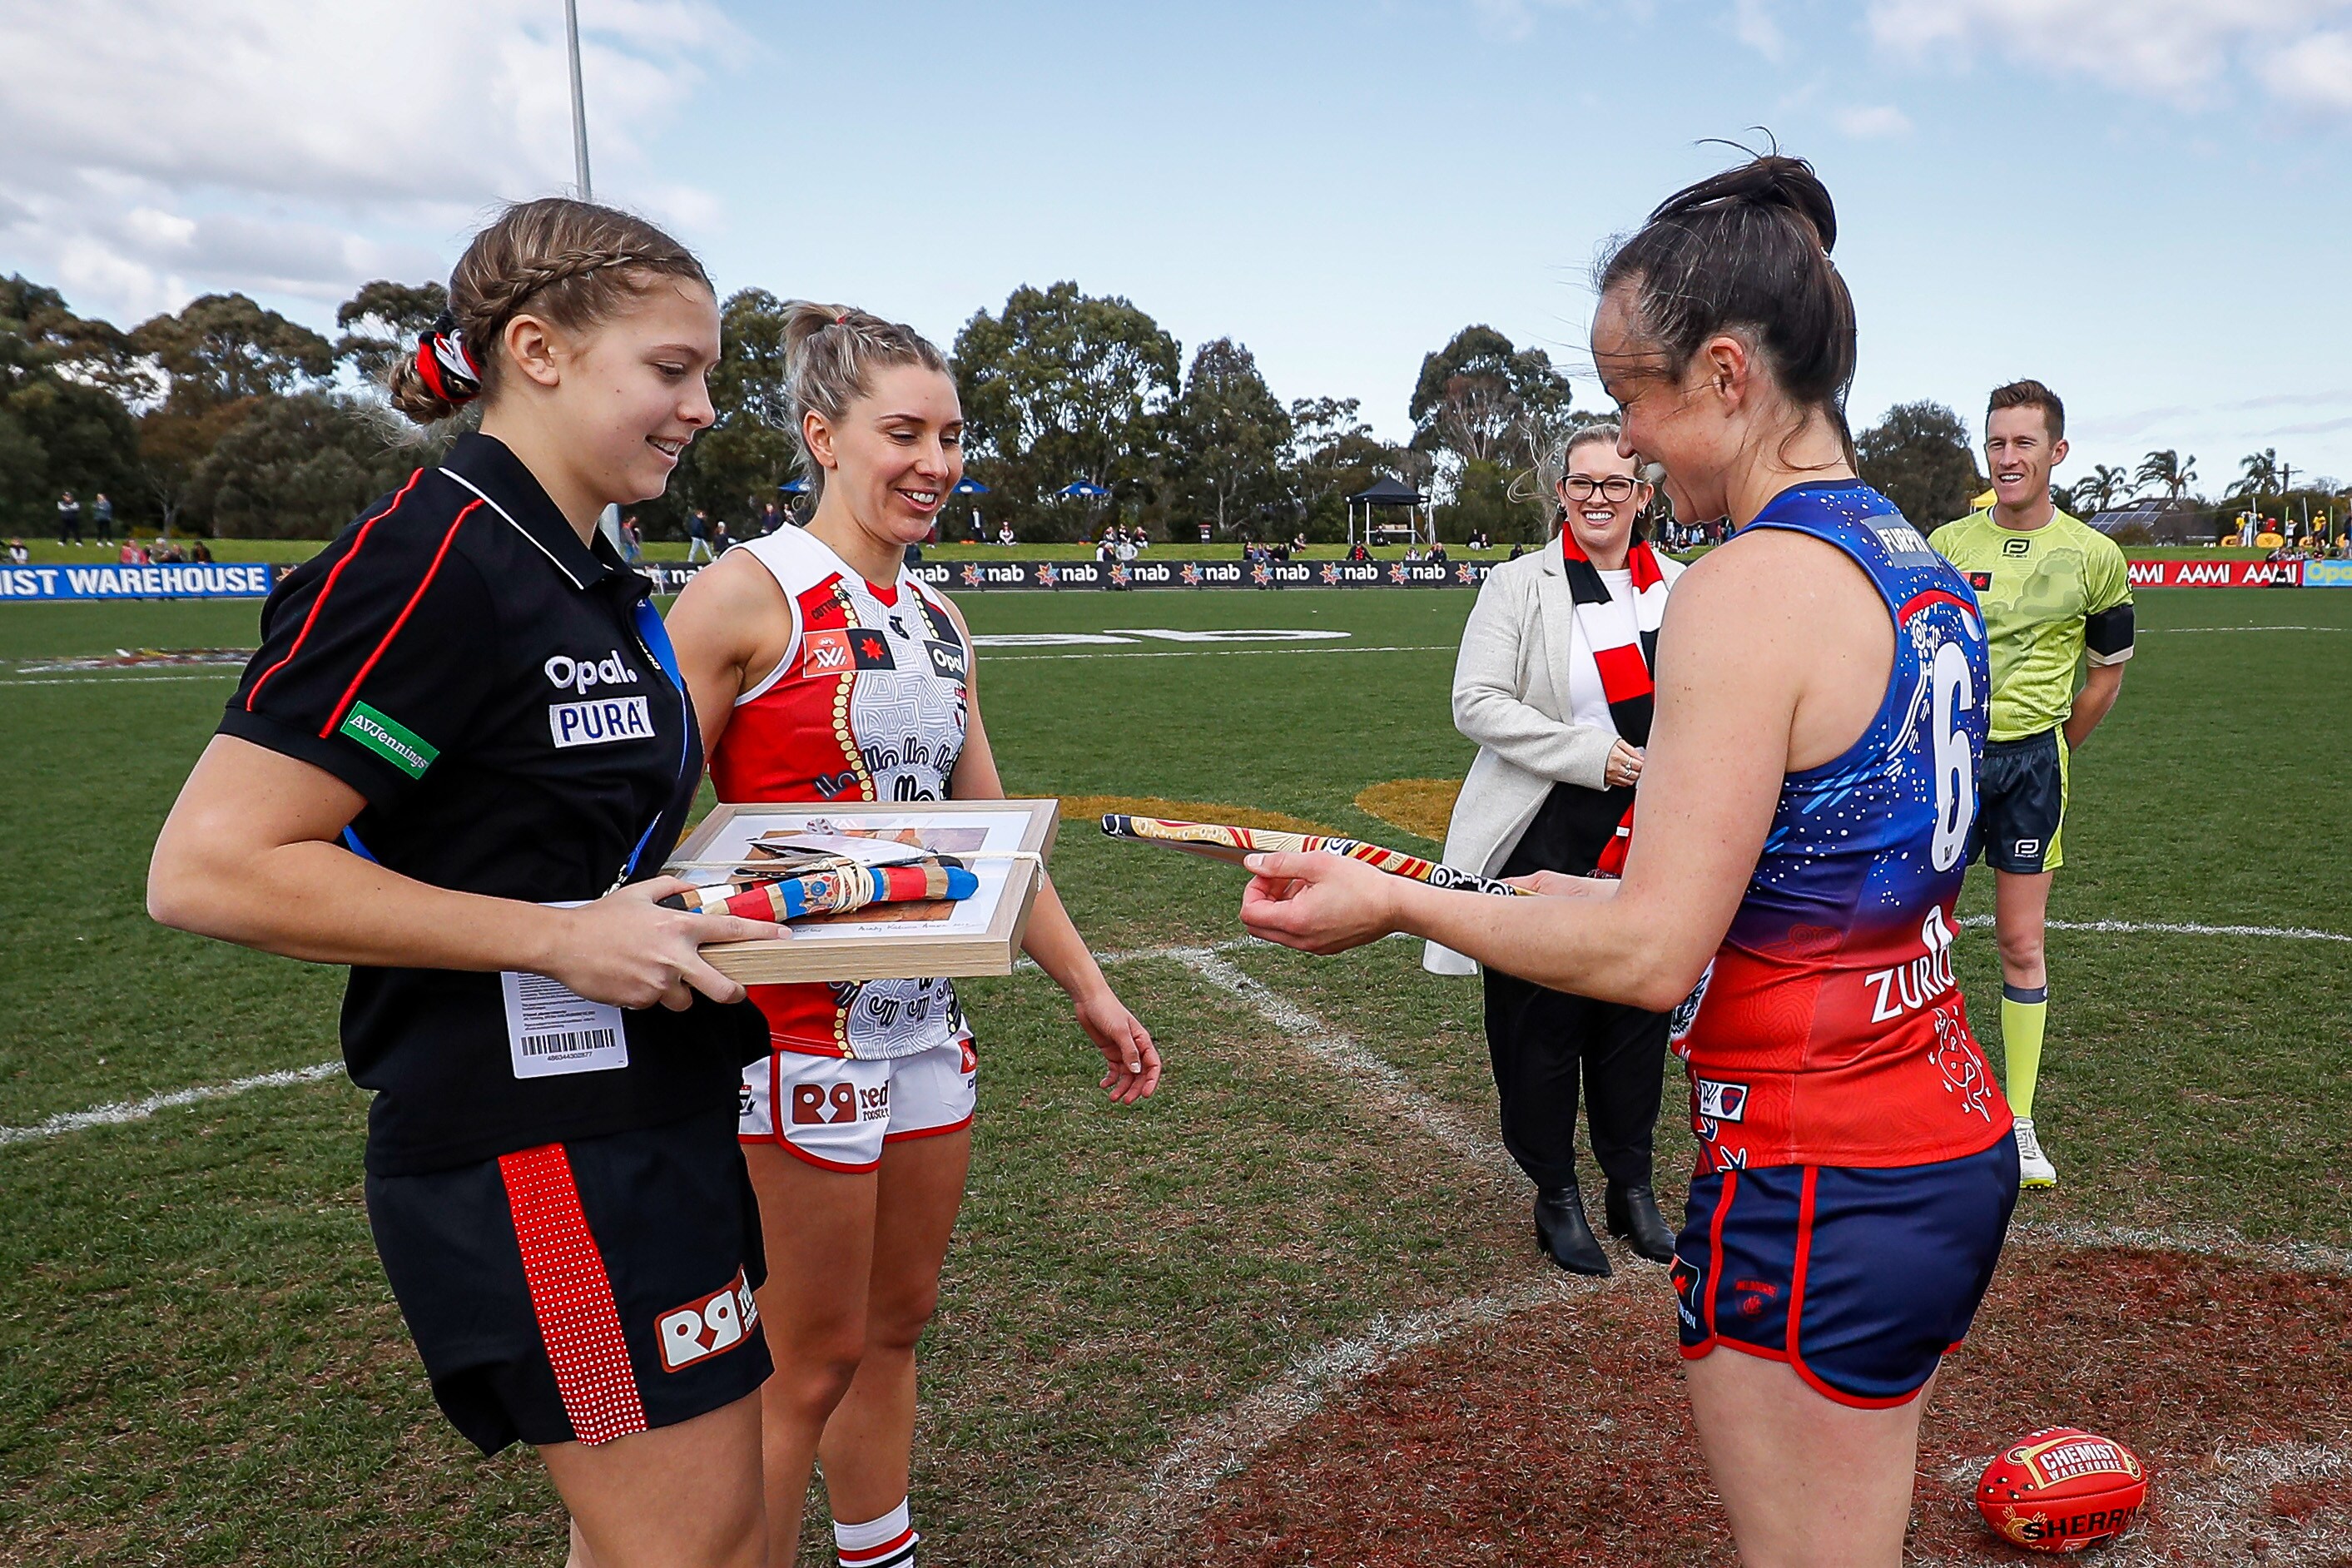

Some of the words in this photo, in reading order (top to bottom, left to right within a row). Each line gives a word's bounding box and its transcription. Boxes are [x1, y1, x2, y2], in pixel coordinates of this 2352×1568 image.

[0, 568, 59, 596] IST
[66, 567, 267, 594] WAREHOUSE
[670, 566, 704, 583] na
[911, 564, 950, 582] nab
[987, 564, 1025, 582] nab
[1061, 564, 1098, 581] nab
[1134, 563, 1170, 581] nab
[1206, 563, 1241, 580] nab
[1275, 563, 1310, 580] nab
[1344, 563, 1378, 580] nab
[1412, 563, 1446, 580] nab
[2127, 563, 2164, 583] AMI
[2176, 563, 2231, 583] AAMI
[559, 701, 645, 742] PURA
[349, 713, 429, 769] AVJennings
[1931, 641, 1973, 872] 6
[1864, 945, 1956, 1024] ZURIC
[859, 1079, 890, 1109] red
[2039, 1444, 2118, 1471] CHEMIST
[2048, 1460, 2122, 1481] WAREHOUSE
